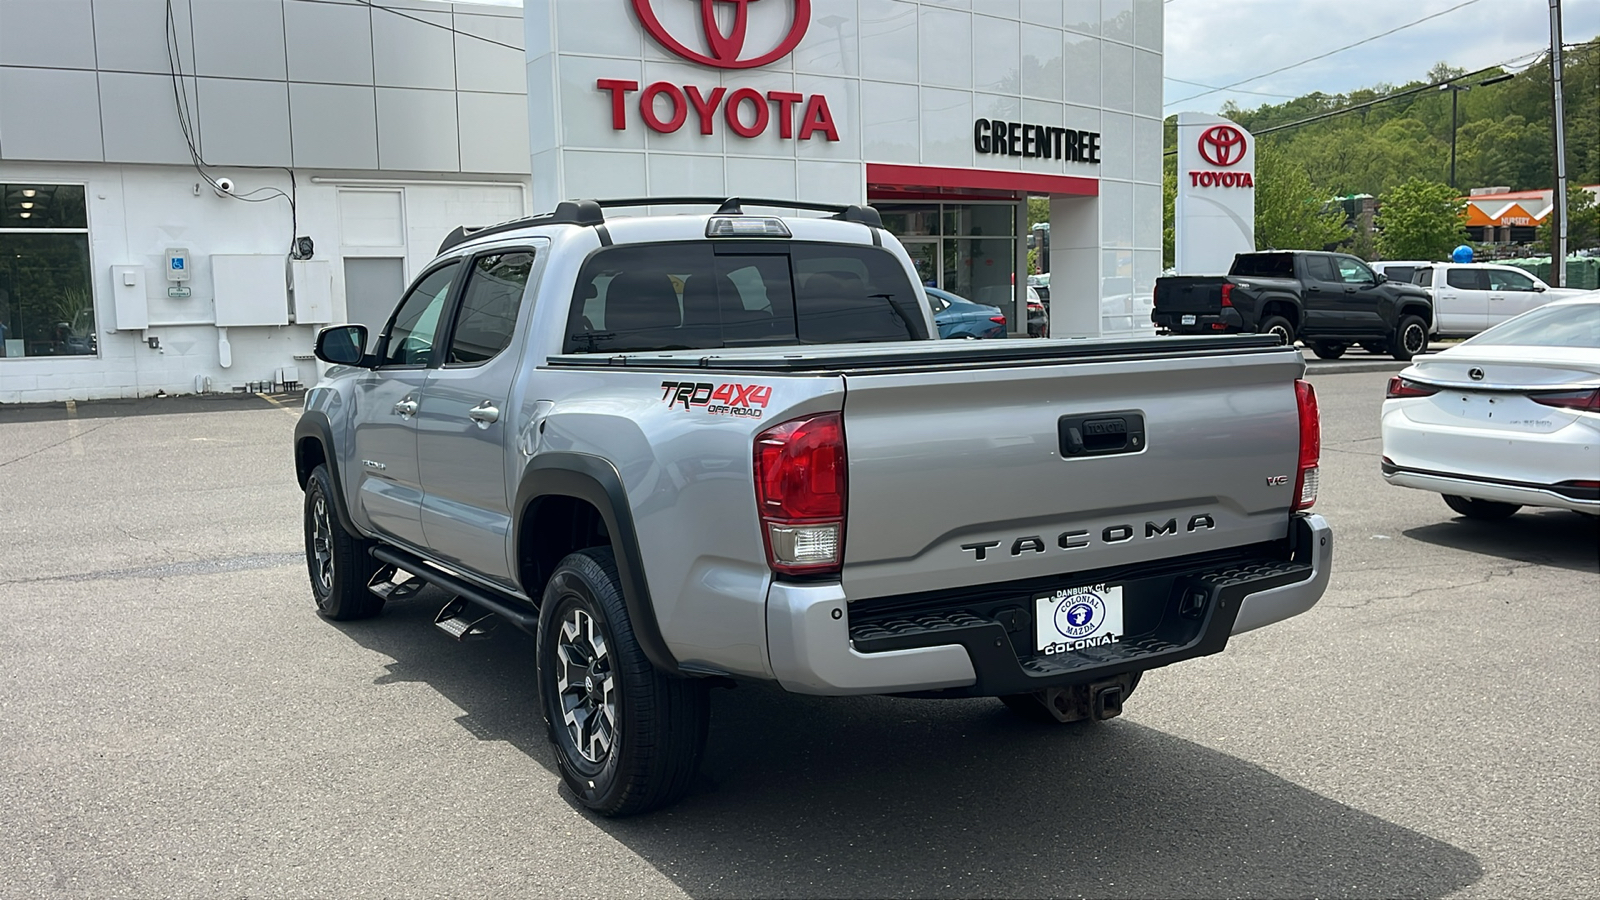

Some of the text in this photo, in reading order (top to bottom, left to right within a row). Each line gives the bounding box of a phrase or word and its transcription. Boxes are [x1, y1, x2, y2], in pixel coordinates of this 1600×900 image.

[597, 79, 839, 141] TOYOTA
[974, 117, 1101, 164] GREENTREE
[1188, 171, 1254, 188] TOYOTA
[1501, 217, 1530, 226] NURSERY
[661, 381, 772, 411] TRD 4X4
[707, 405, 762, 419] OFF ROAD
[1088, 423, 1126, 433] TOYOTA
[961, 513, 1216, 561] TACOMA
[1095, 583, 1106, 592] CT
[1061, 595, 1099, 613] COLONIAL
[1065, 622, 1096, 636] MAZDA
[1044, 634, 1120, 655] COLONIAL
